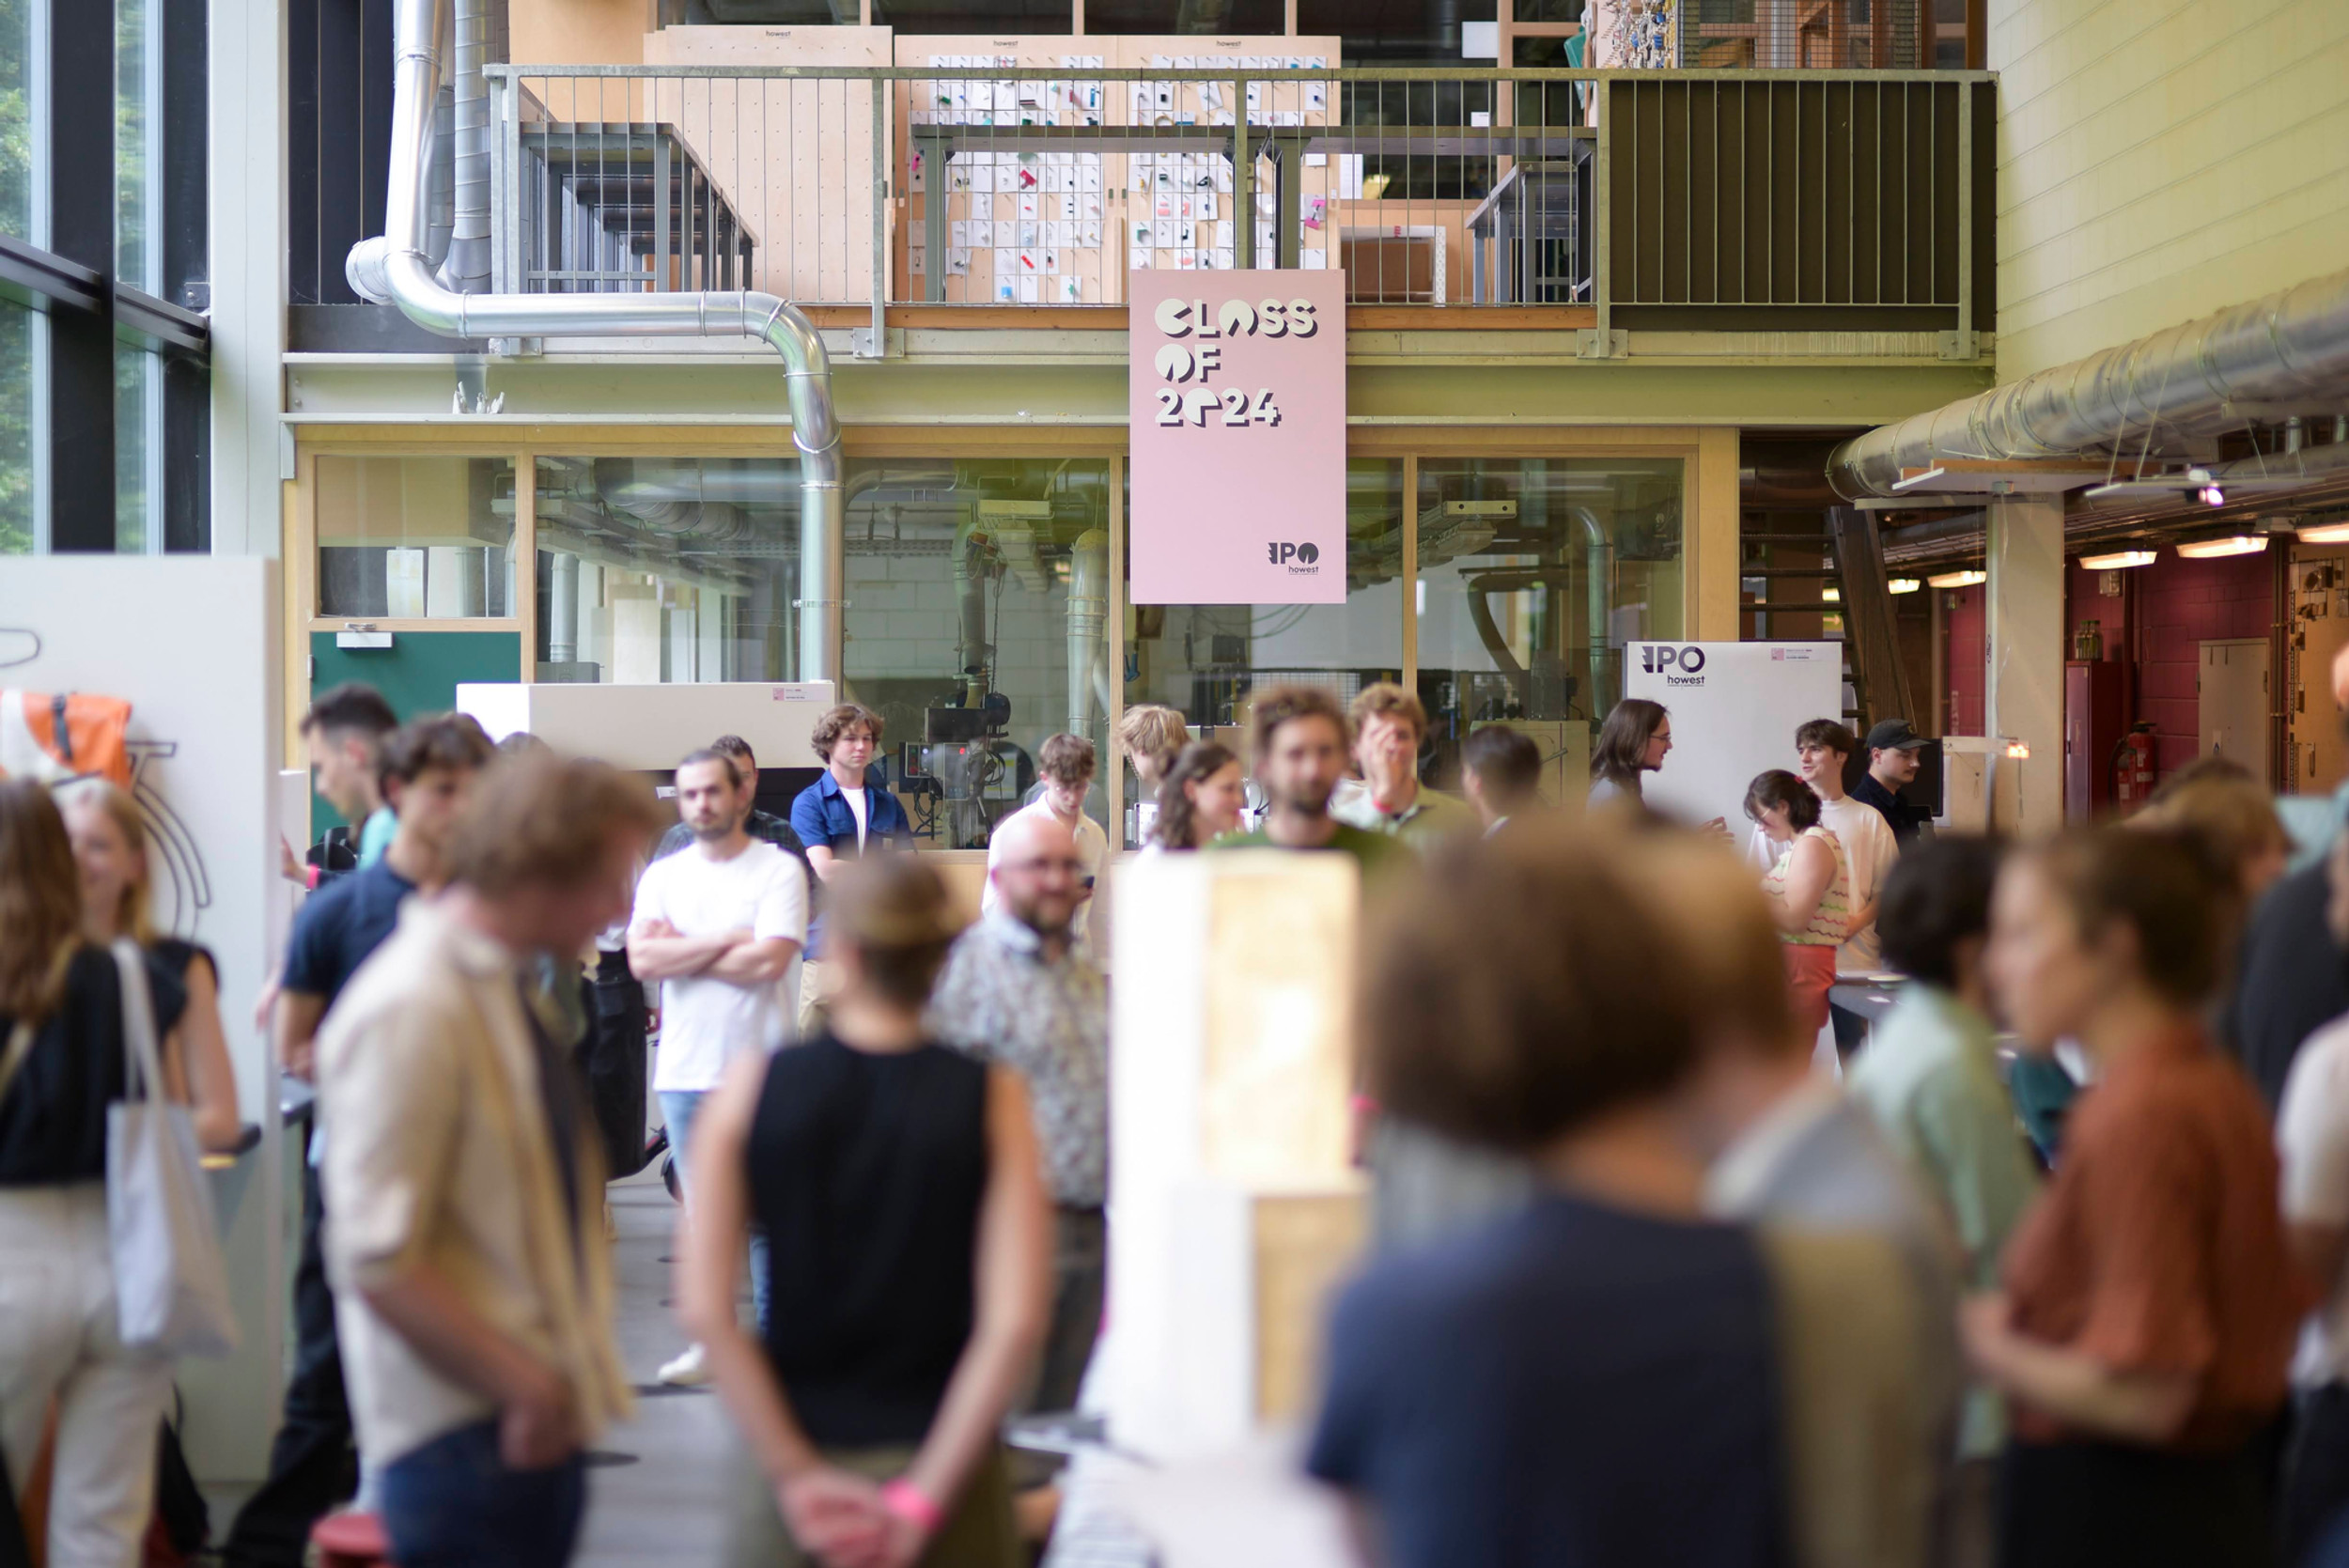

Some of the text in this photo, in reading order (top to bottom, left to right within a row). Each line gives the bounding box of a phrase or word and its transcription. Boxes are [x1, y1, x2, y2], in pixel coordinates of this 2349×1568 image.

[1155, 298, 1318, 338] CLASS
[1155, 343, 1221, 383] OF
[1155, 387, 1282, 427] 2024
[1268, 542, 1319, 565] IPO
[1641, 645, 1705, 674] IPO
[1667, 675, 1705, 684] howest
